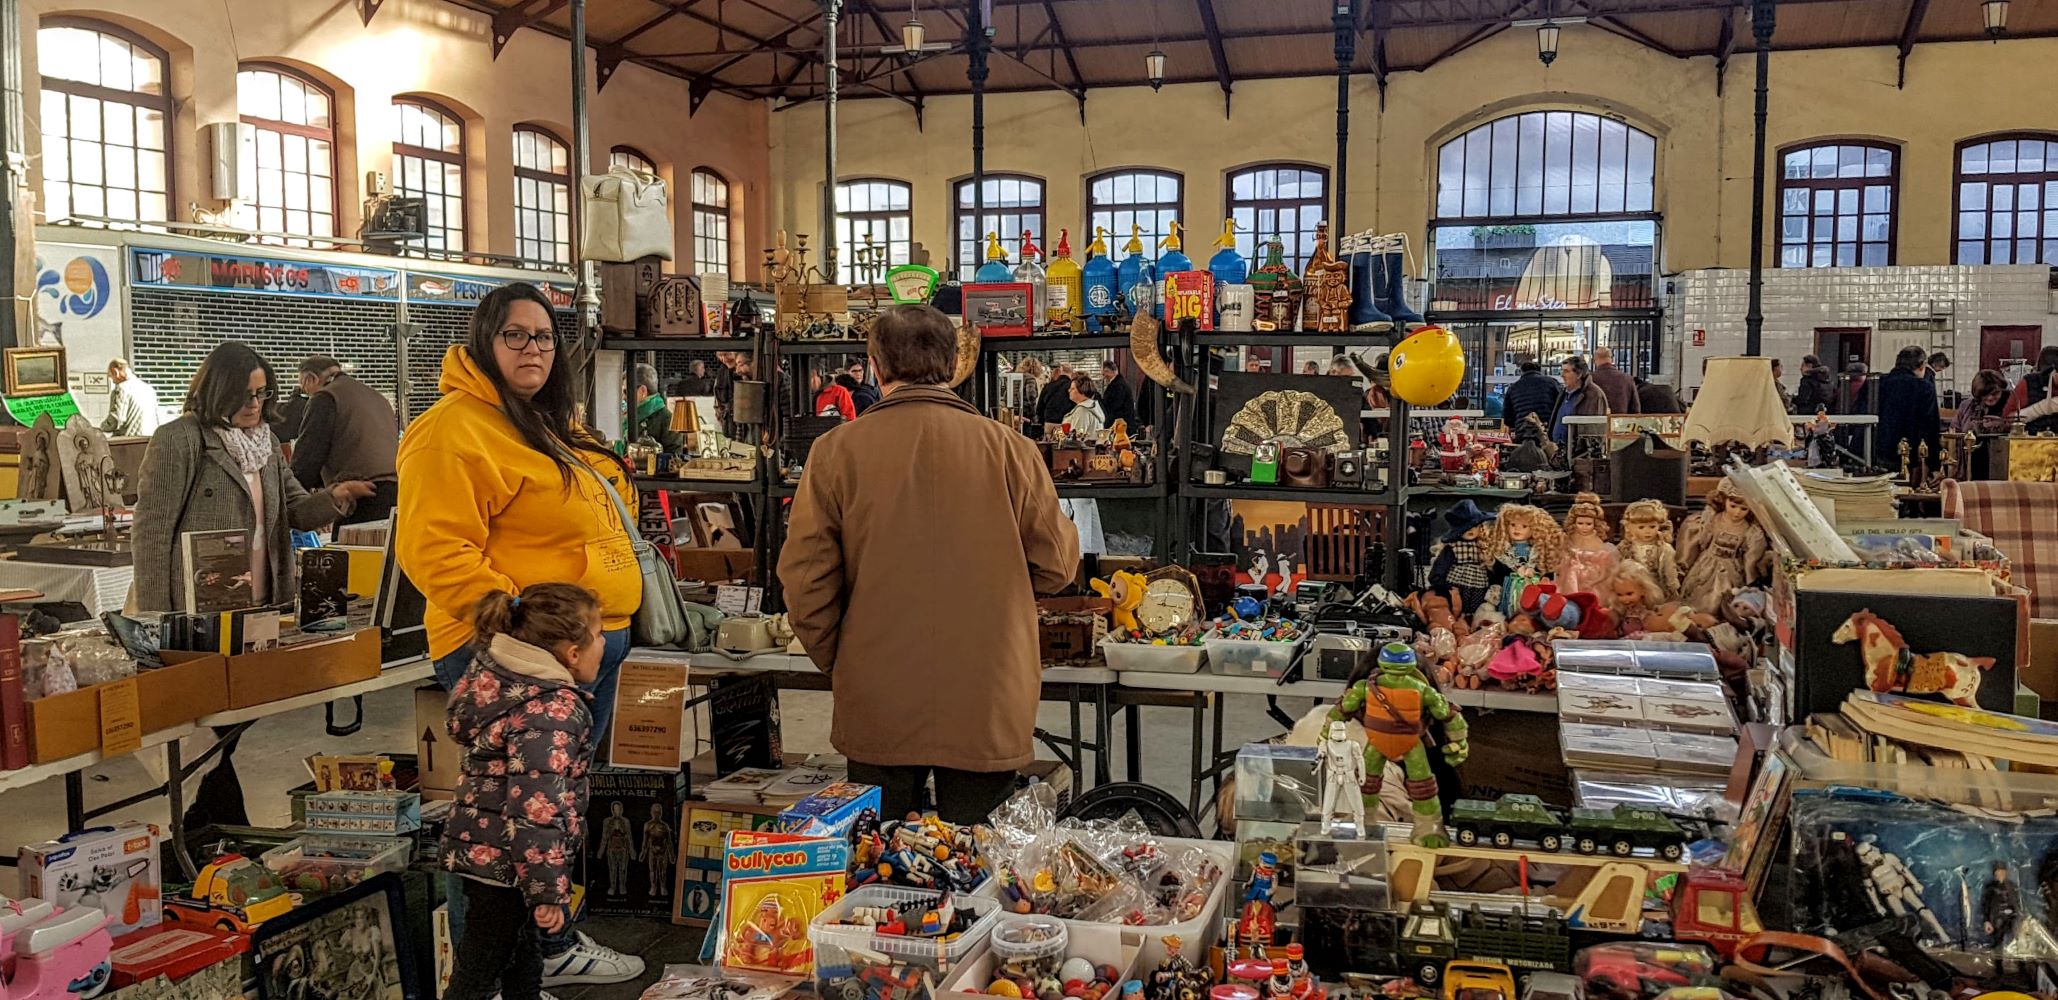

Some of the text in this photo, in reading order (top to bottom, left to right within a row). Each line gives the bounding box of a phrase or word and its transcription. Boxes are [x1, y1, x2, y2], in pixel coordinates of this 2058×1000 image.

[210, 260, 310, 290] MARISCOS
[1173, 295, 1202, 319] BIG
[1494, 294, 1513, 310] El
[728, 850, 808, 872] bullycan
